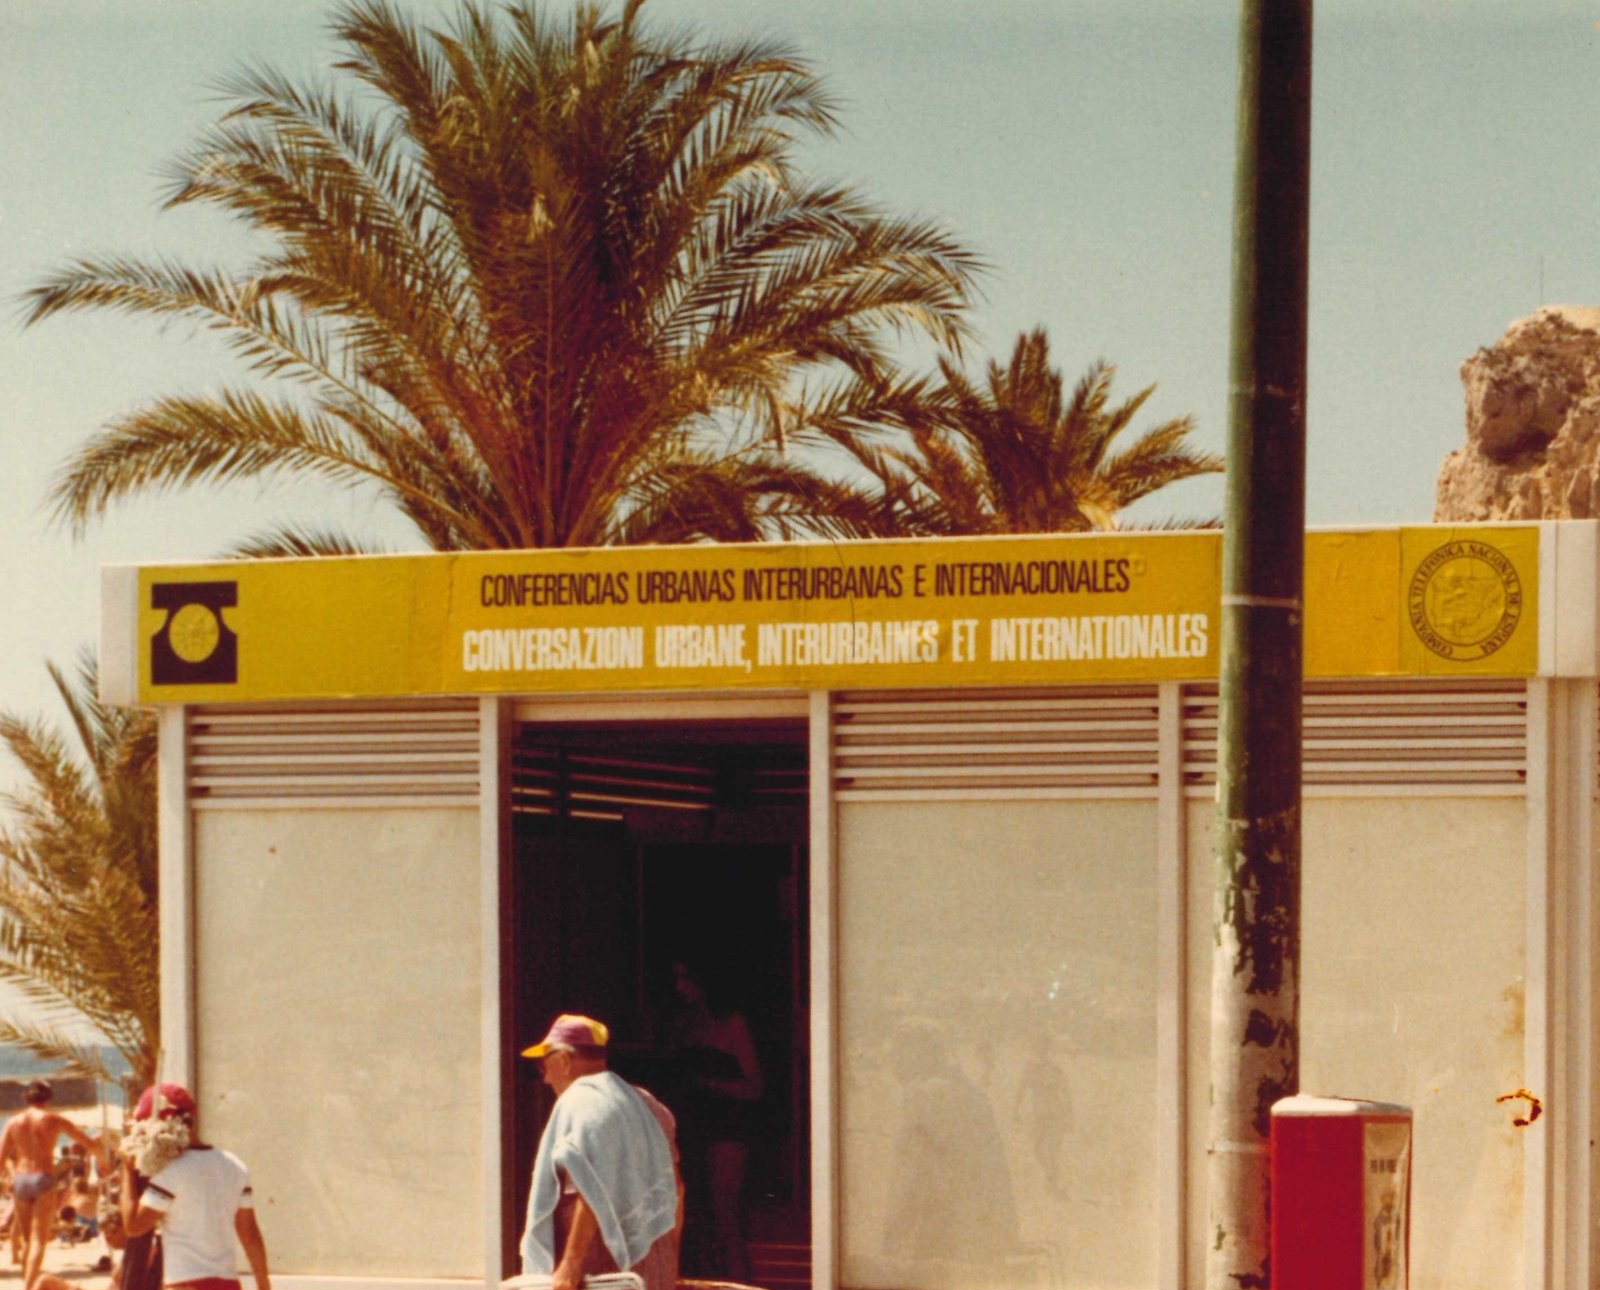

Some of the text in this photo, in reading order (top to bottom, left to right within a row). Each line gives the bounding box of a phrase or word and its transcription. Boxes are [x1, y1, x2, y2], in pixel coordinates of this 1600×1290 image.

[480, 558, 1131, 607] CONFERENCIAS URBANAS INTERURBANAS E INTERNACIONALES
[463, 613, 1208, 673] CONVERSAZIONI URBANE, INTERURBAINES ET INTERNATIONALES
